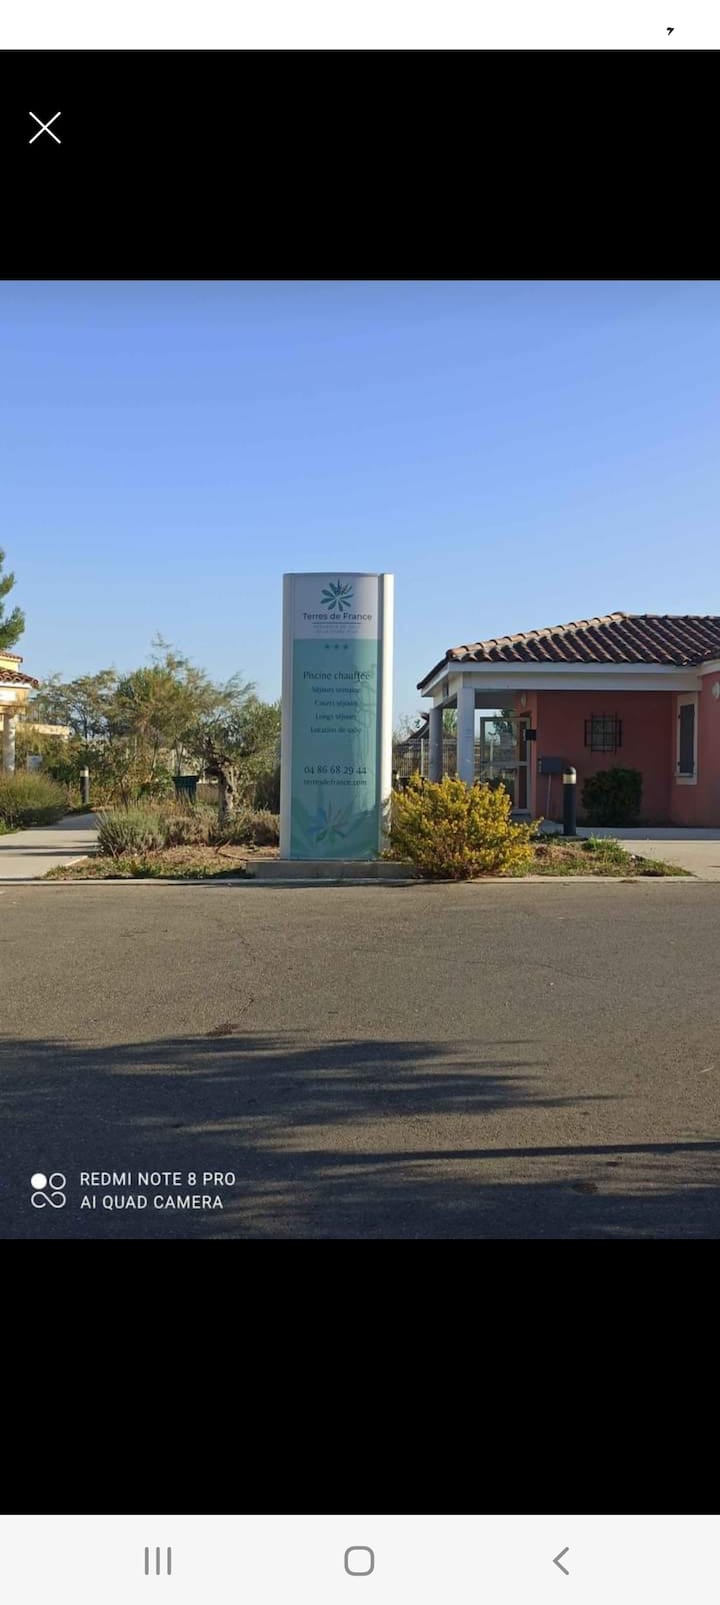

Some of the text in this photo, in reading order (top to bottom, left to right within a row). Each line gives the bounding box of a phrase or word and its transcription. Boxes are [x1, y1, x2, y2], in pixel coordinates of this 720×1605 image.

[302, 612, 373, 621] Terres de France
[303, 671, 332, 680] Piscine
[303, 764, 367, 775] 04 86 68 29 44
